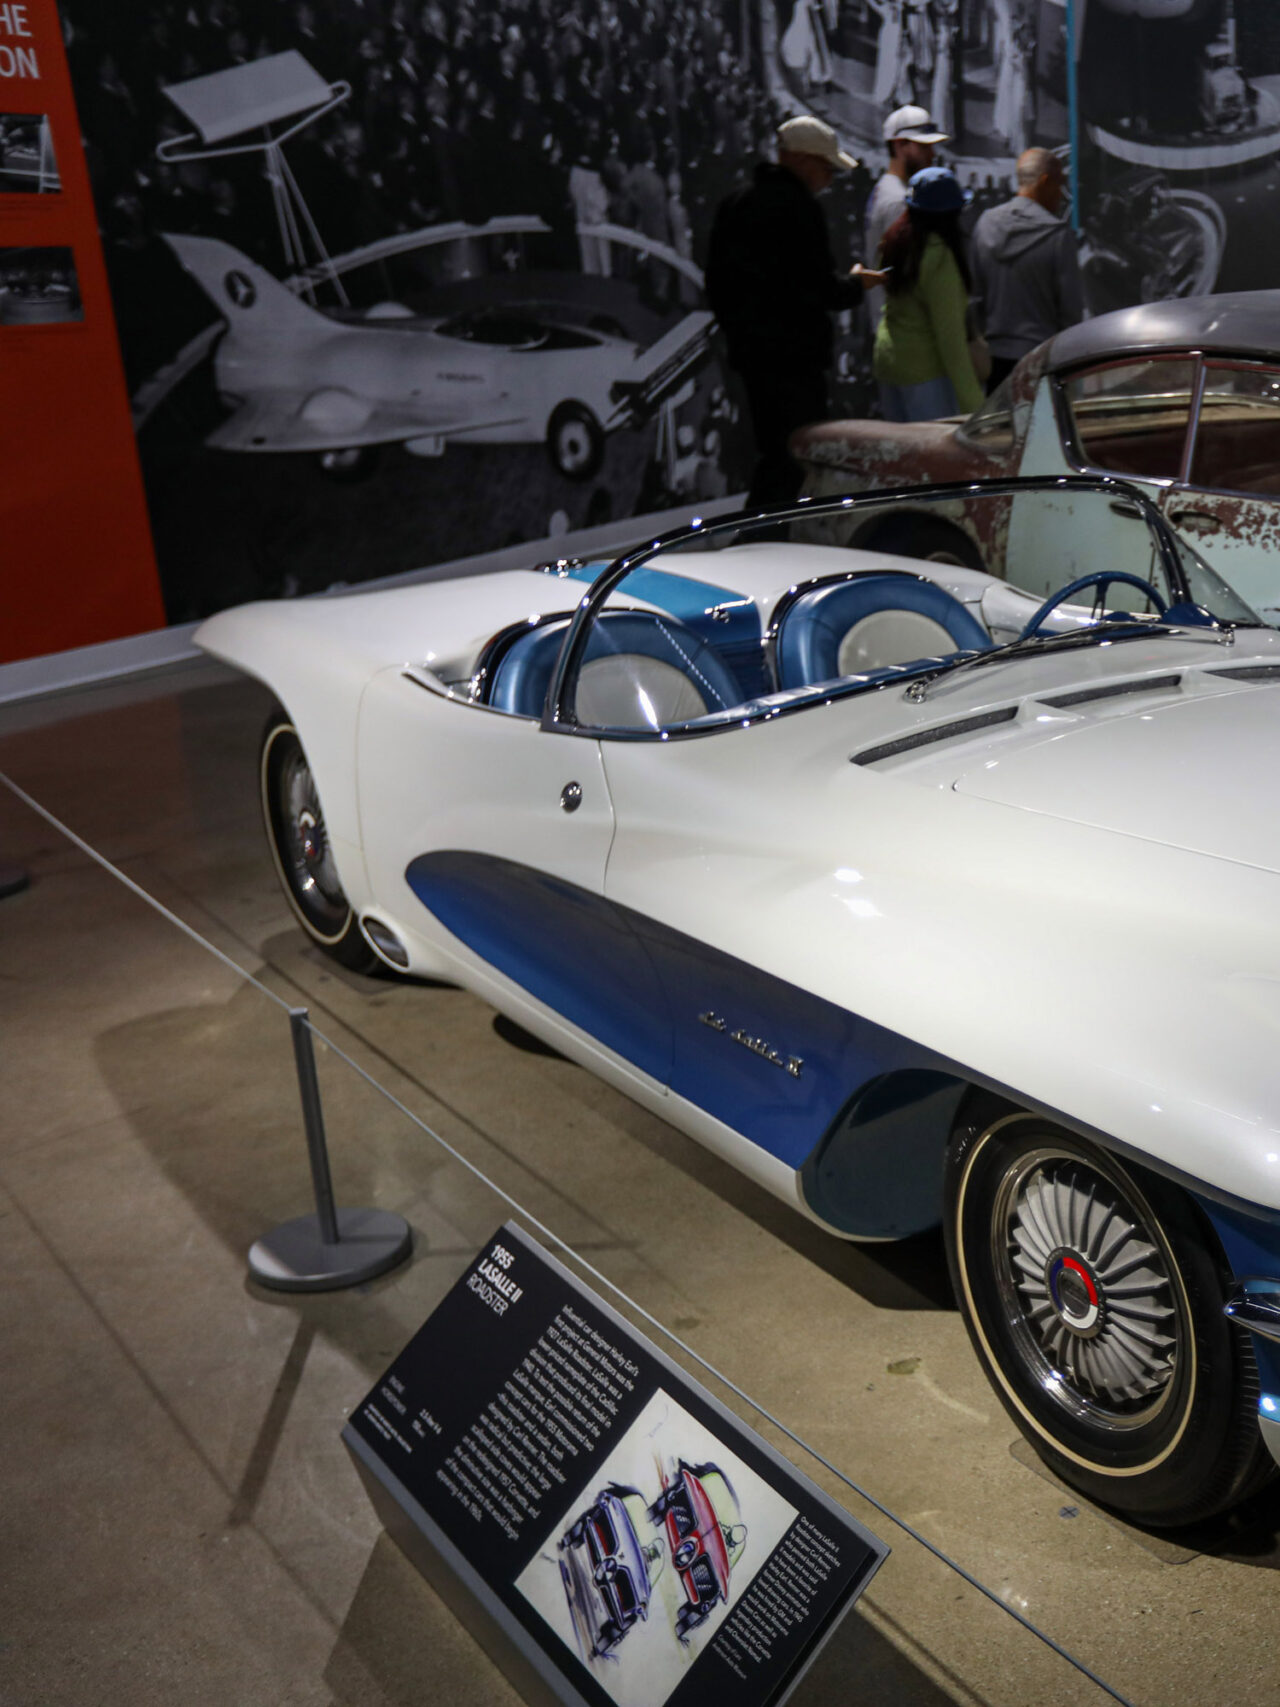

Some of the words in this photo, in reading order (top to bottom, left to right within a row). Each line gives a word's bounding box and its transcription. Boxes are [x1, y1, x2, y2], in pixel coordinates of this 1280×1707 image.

[490, 1243, 514, 1269] 1955
[466, 1272, 509, 1316] ROADSTER
[477, 1258, 516, 1297] LASALLE
[509, 1287, 523, 1303] II
